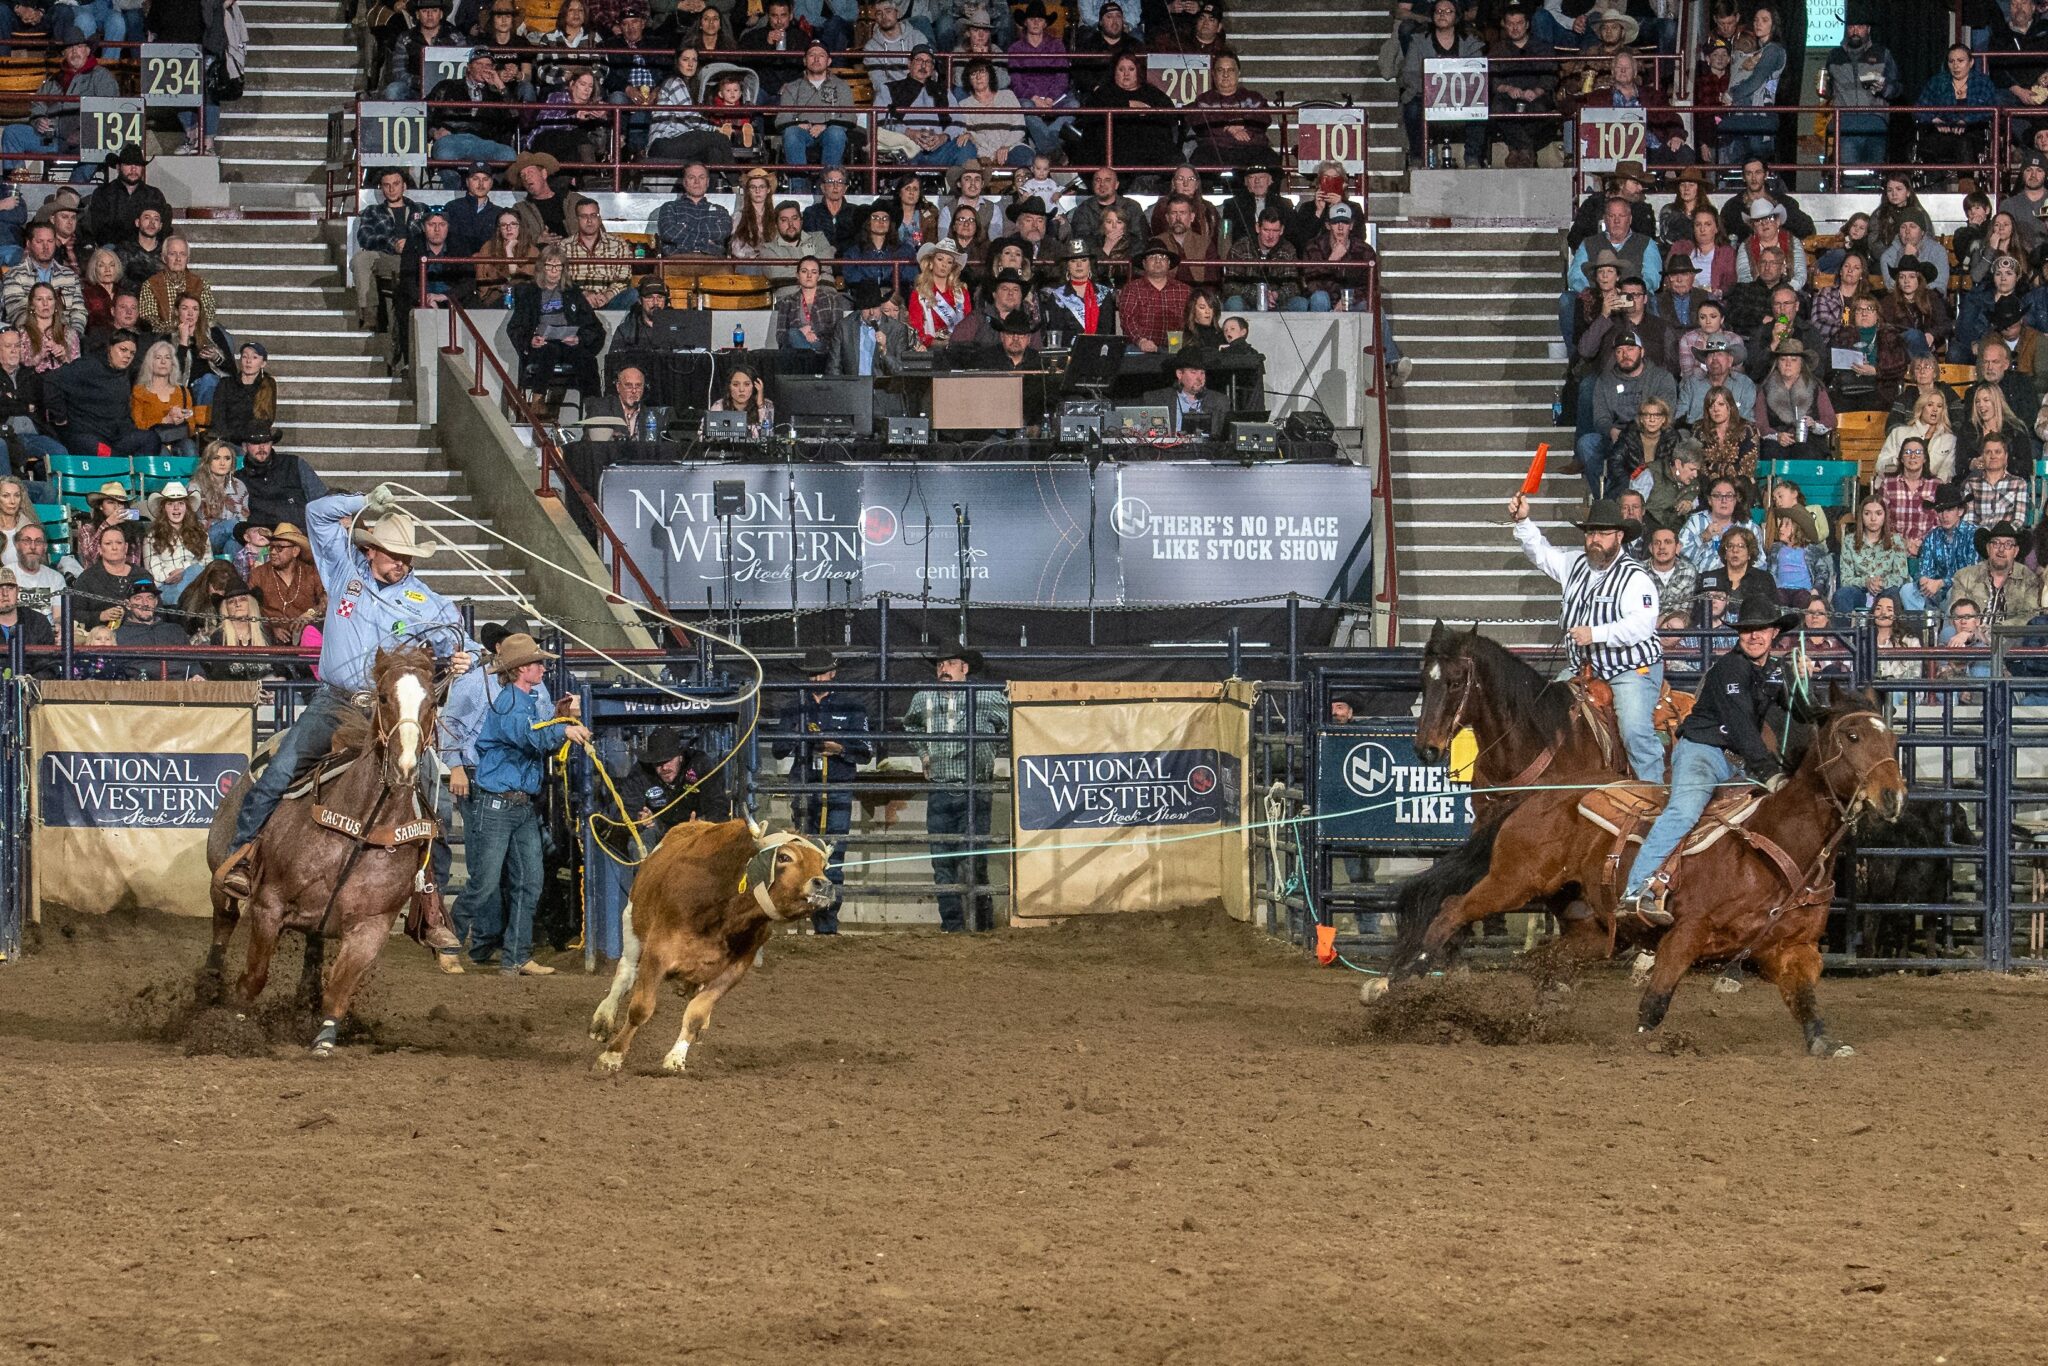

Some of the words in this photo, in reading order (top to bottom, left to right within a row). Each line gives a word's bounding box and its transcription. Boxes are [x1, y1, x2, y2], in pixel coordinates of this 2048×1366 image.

[148, 58, 201, 95] 234
[1431, 72, 1485, 108] 202
[93, 112, 142, 151] 134
[378, 117, 425, 156] 101
[1316, 124, 1361, 162] 101
[1595, 122, 1645, 162] 102
[81, 460, 90, 471] 8
[163, 461, 171, 472] 9
[1815, 465, 1824, 476] 3
[628, 489, 836, 528] NATONAL
[1149, 515, 1234, 537] THERE'S
[1241, 516, 1268, 537] NO
[1275, 516, 1339, 538] PLACE
[664, 526, 864, 562] WESTERN
[1153, 539, 1200, 560] LIKE
[1206, 539, 1273, 561] STOCK
[1280, 540, 1339, 561] SHOW
[733, 557, 792, 584] Stock
[798, 557, 865, 582] Show
[47, 754, 199, 785] NATIONAL
[1021, 756, 1171, 789] NATIONAL
[73, 782, 217, 811] WESTERN
[1049, 783, 1188, 812] WESTERN
[1395, 796, 1454, 824] LIKE
[123, 806, 167, 826] Stock
[321, 809, 362, 835] CACTUS
[1099, 807, 1141, 825] Stock
[1145, 804, 1190, 822] Show
